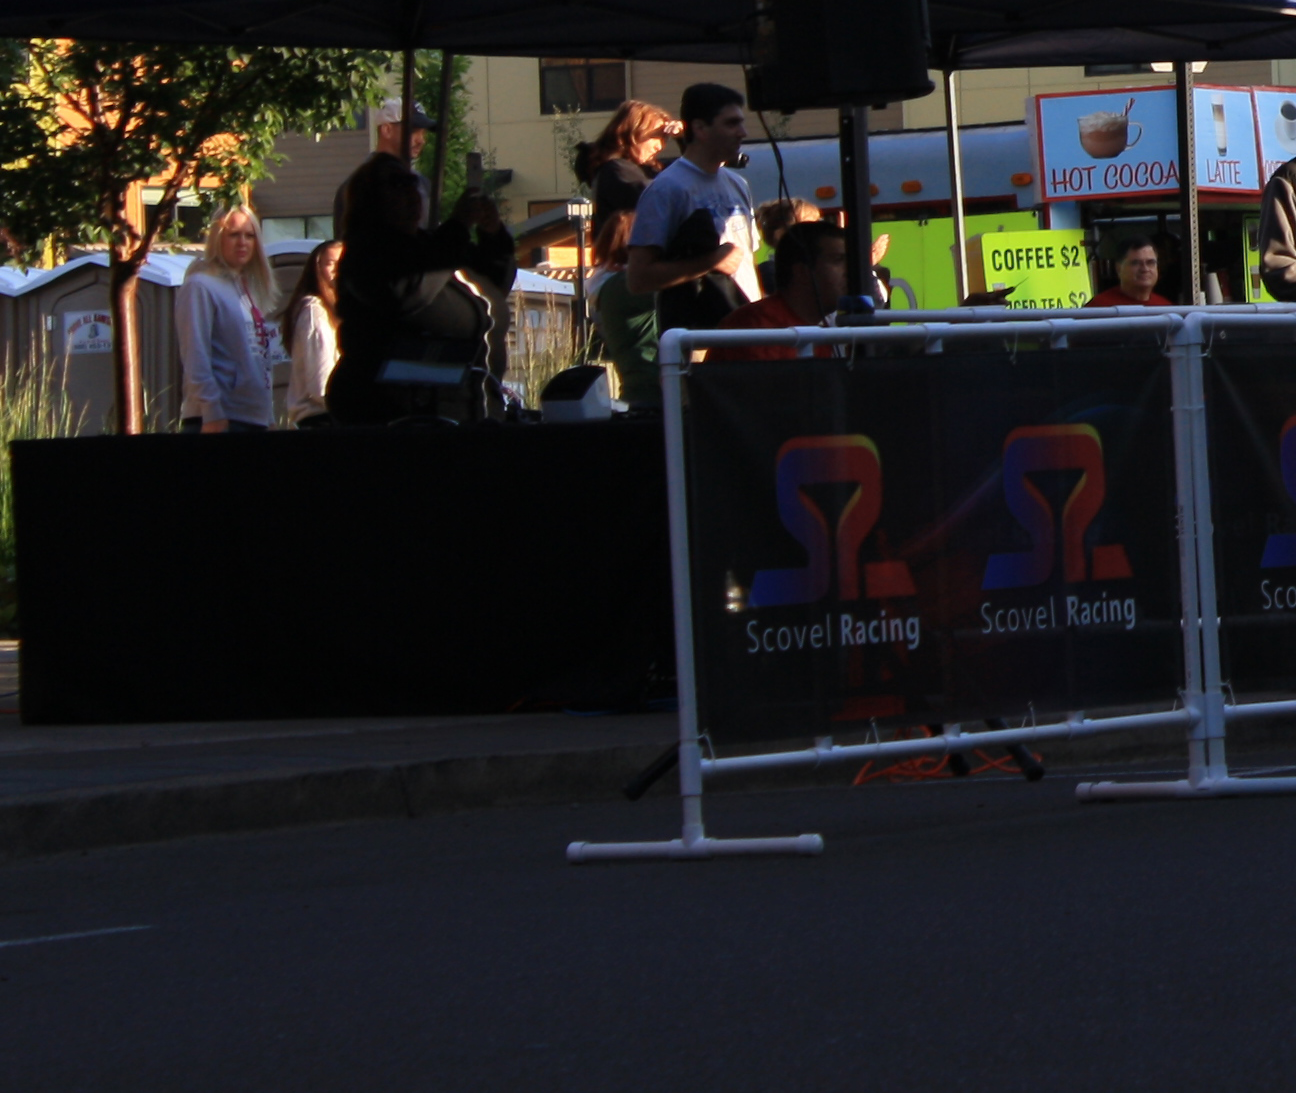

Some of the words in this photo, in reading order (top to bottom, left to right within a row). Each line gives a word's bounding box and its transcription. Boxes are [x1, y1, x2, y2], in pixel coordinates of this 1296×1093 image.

[1050, 164, 1097, 194] HOT
[1103, 160, 1180, 190] COCOA
[1206, 159, 1243, 186] LATTE
[991, 246, 1056, 272] COFFEE
[1060, 244, 1081, 270] $2
[980, 596, 1055, 635] Scovel
[1066, 591, 1137, 630] Racing
[746, 613, 832, 654] Scovel
[840, 610, 920, 650] Racing
